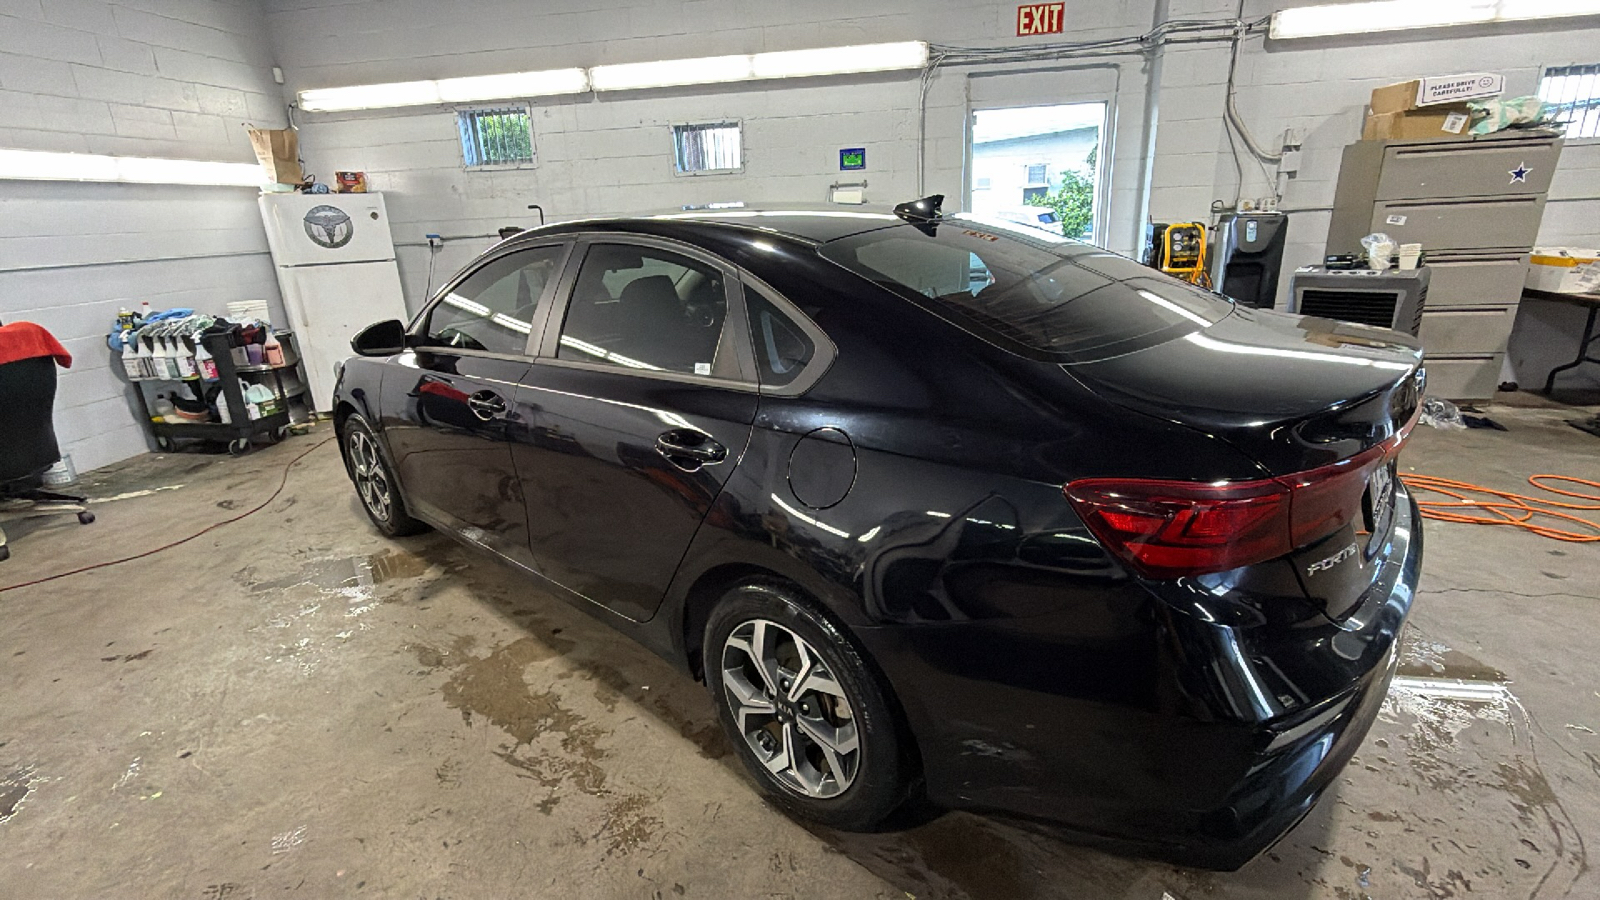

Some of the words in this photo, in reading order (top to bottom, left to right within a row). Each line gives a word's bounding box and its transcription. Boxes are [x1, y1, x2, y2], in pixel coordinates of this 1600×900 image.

[1019, 4, 1062, 34] EXIT
[1431, 82, 1455, 91] PLEASE
[1456, 79, 1476, 87] DRIVE
